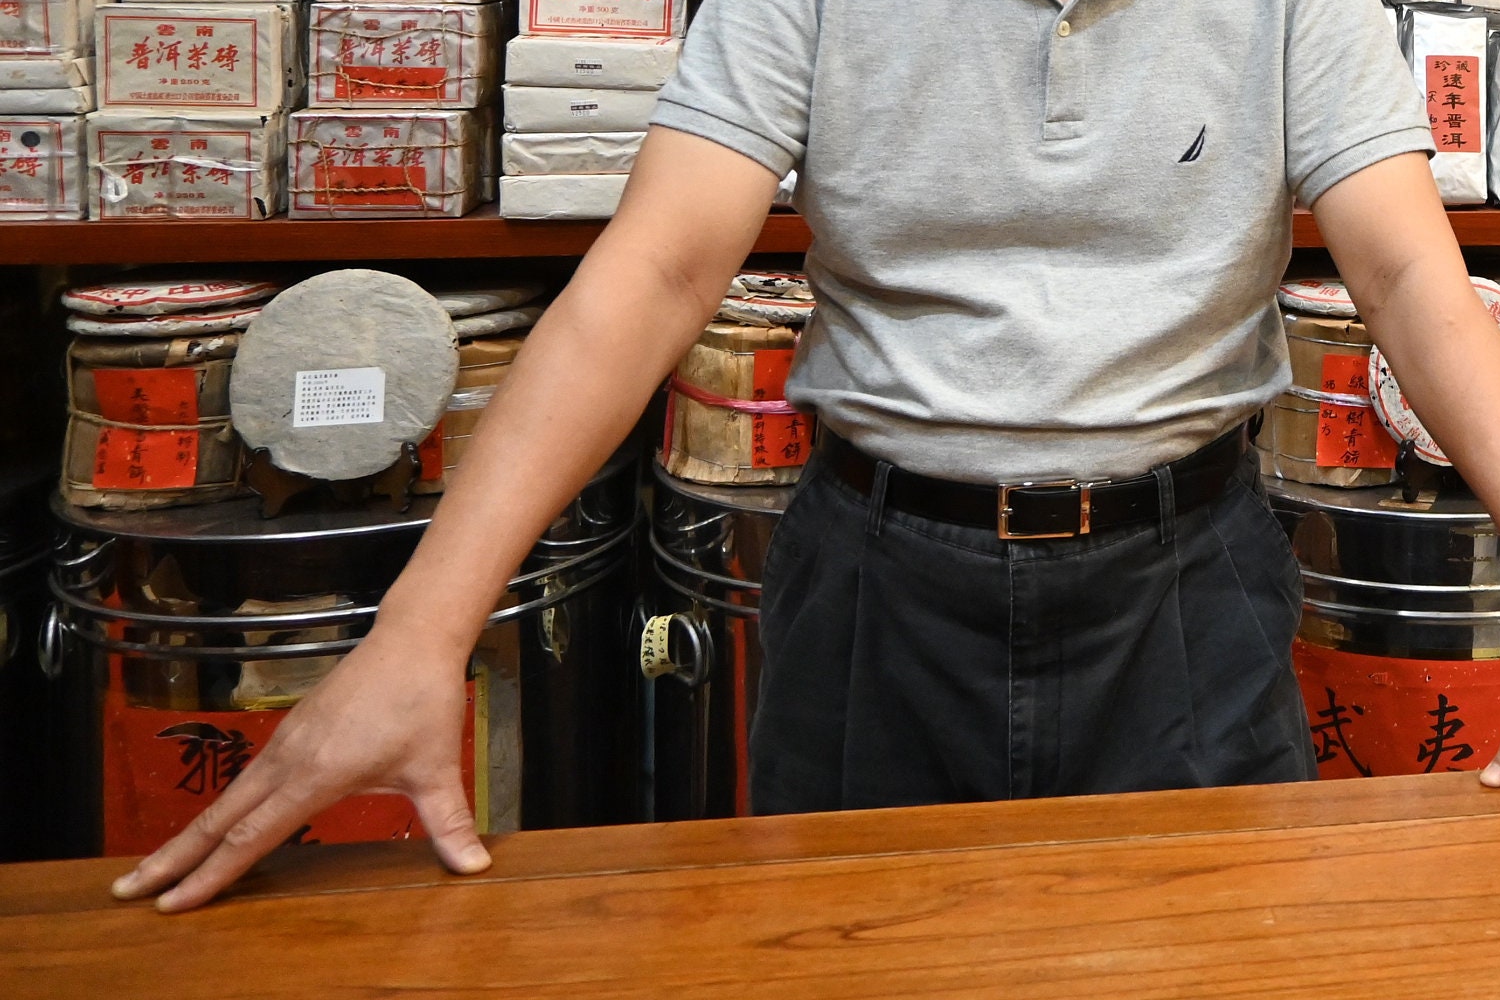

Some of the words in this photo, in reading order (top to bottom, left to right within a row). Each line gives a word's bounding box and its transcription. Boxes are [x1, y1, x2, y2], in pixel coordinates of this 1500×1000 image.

[156, 24, 215, 38] 雲南
[125, 36, 241, 73] 普洱茶磚
[1433, 59, 1471, 73] 珍藏
[343, 125, 400, 139] 雲南
[150, 138, 208, 151] 雲南
